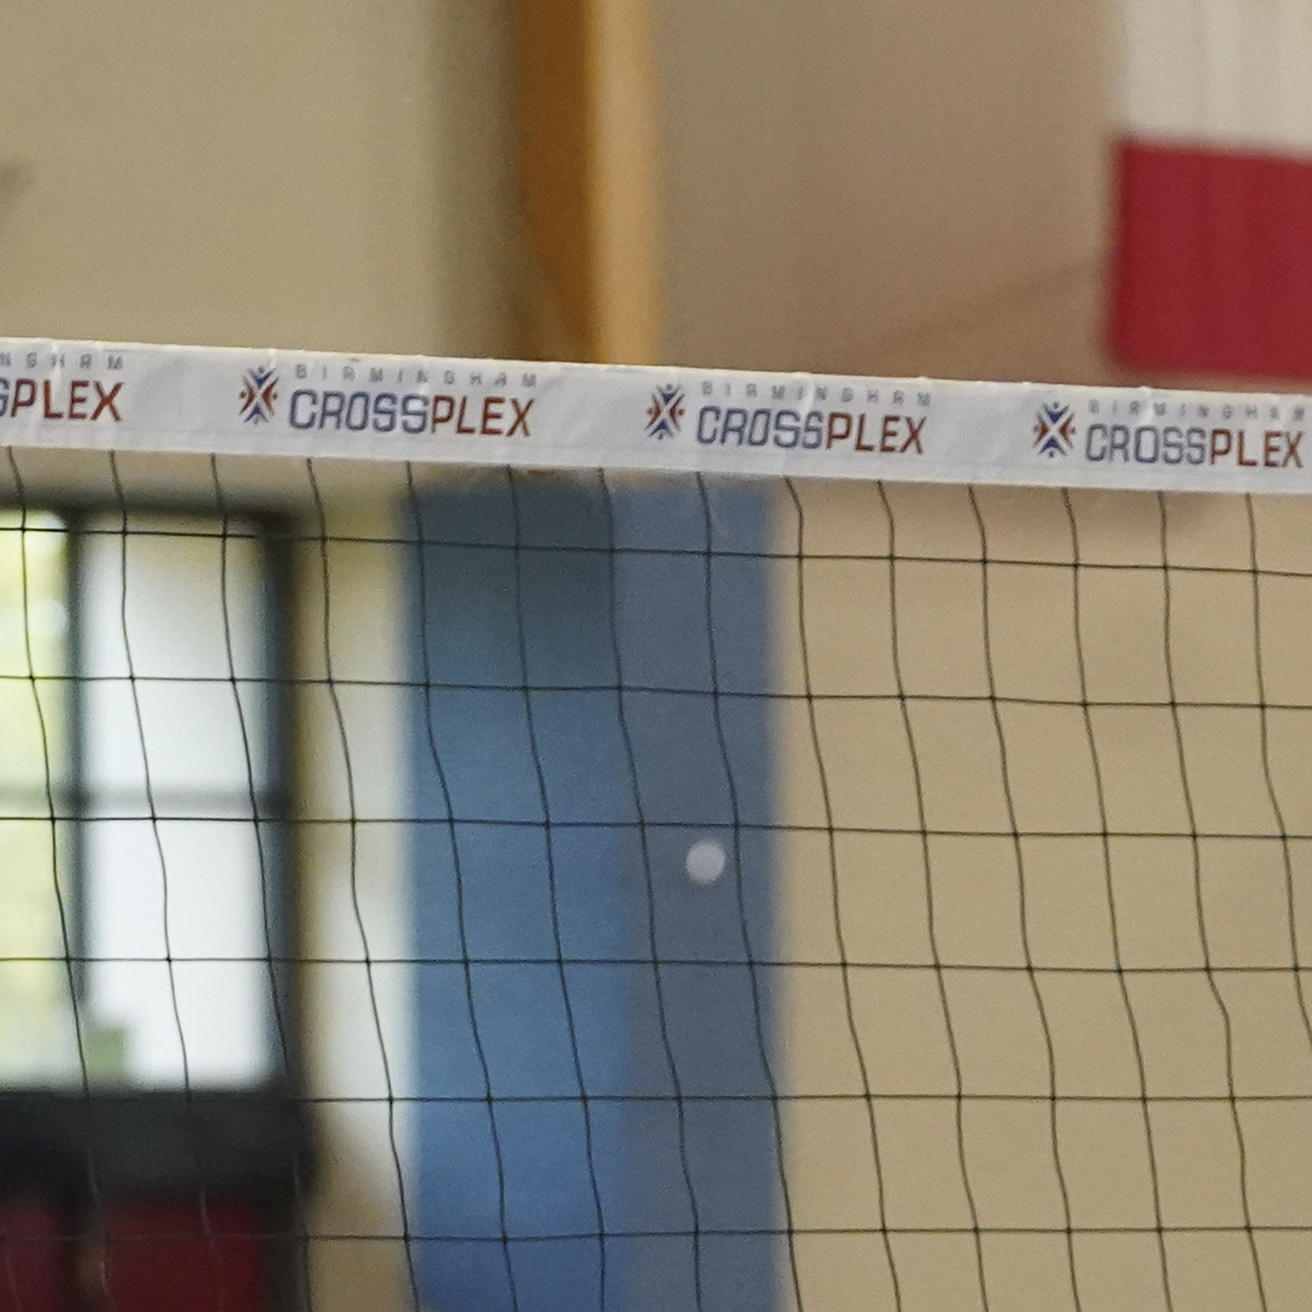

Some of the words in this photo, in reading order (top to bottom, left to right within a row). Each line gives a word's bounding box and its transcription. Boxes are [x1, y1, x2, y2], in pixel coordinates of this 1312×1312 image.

[289, 388, 534, 437] CROSSPLEX
[698, 405, 927, 454] CROSSPLEX
[1085, 423, 1303, 469] CROSSPLEX
